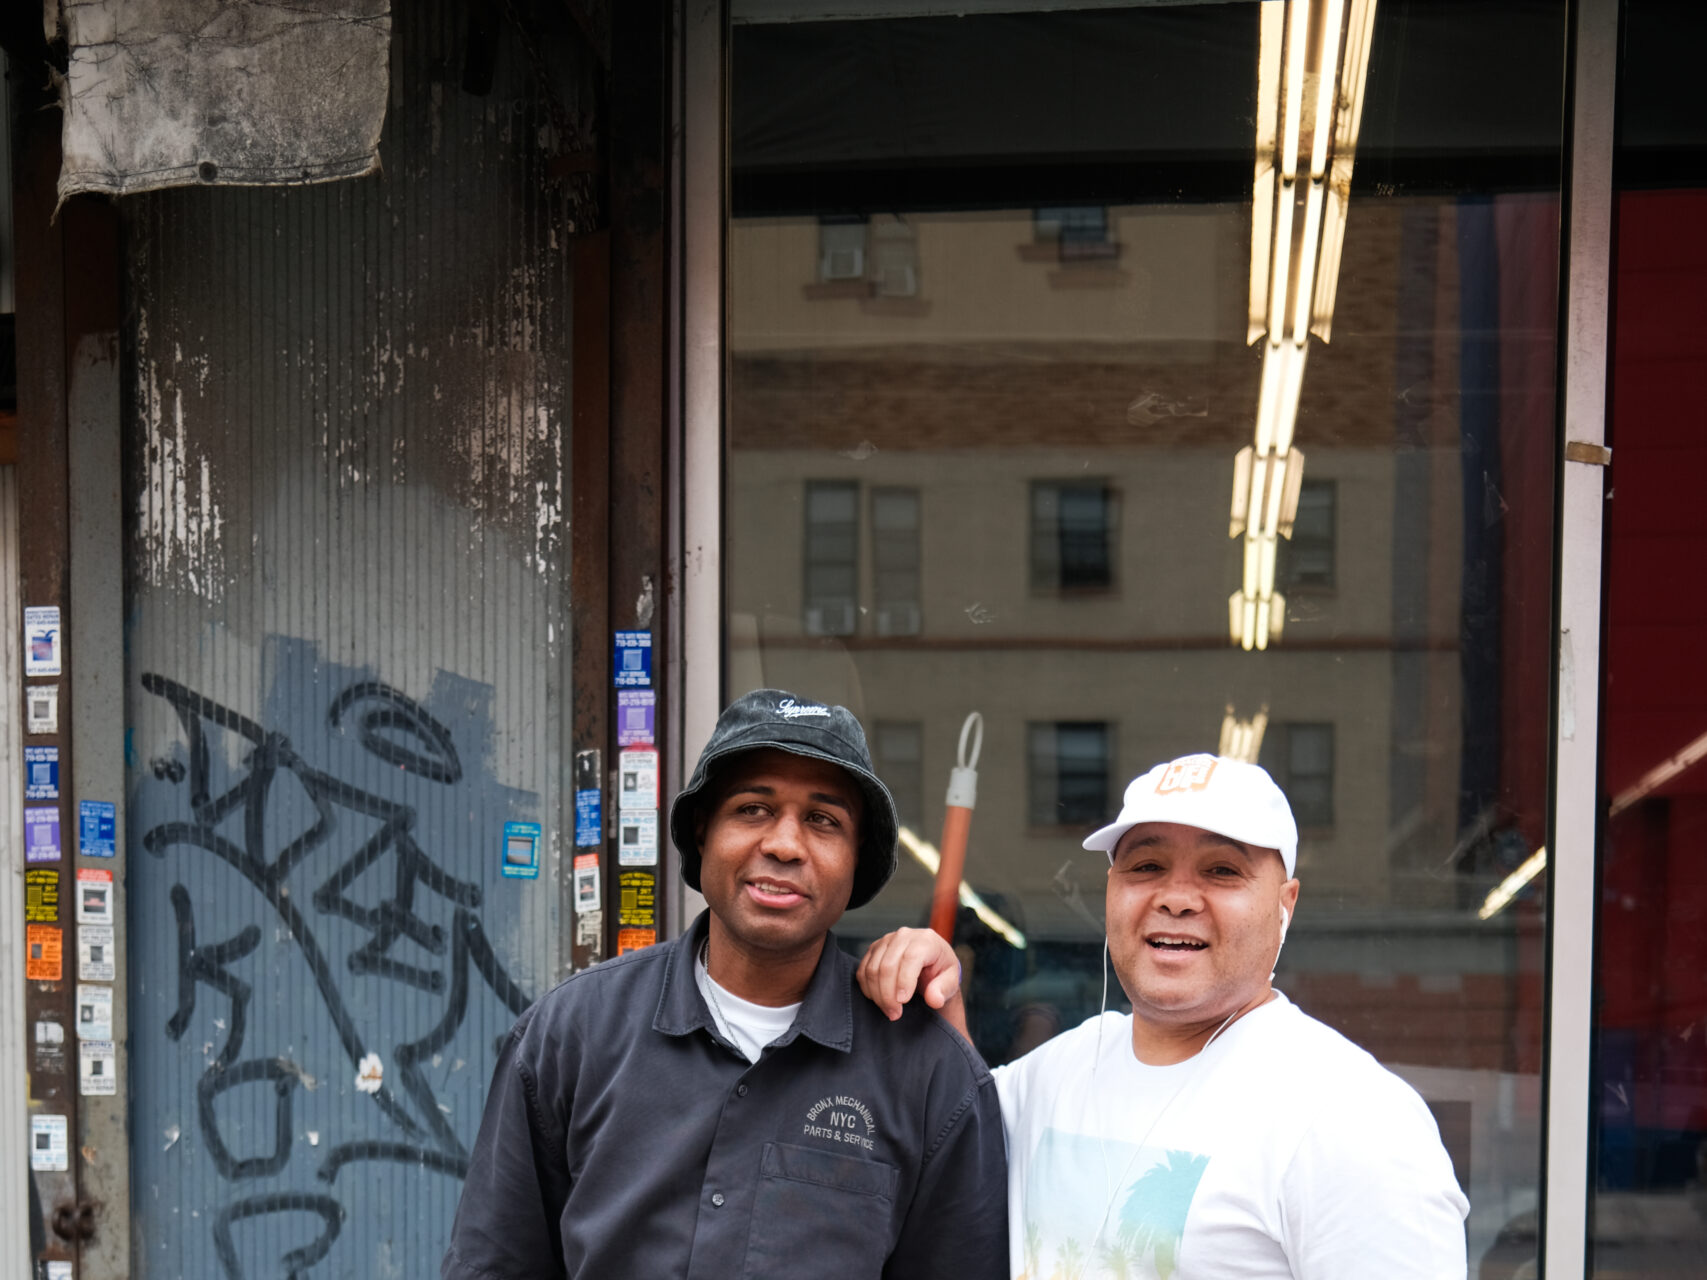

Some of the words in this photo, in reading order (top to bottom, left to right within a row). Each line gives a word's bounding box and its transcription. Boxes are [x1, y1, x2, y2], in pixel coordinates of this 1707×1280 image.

[776, 699, 831, 718] Supreme
[806, 1097, 834, 1122] BRONX
[835, 1096, 876, 1136] MECHANICAL
[830, 1111, 856, 1129] NYC
[803, 1124, 832, 1139] PARTS
[833, 1131, 842, 1142] &
[844, 1132, 874, 1151] SERVICE
